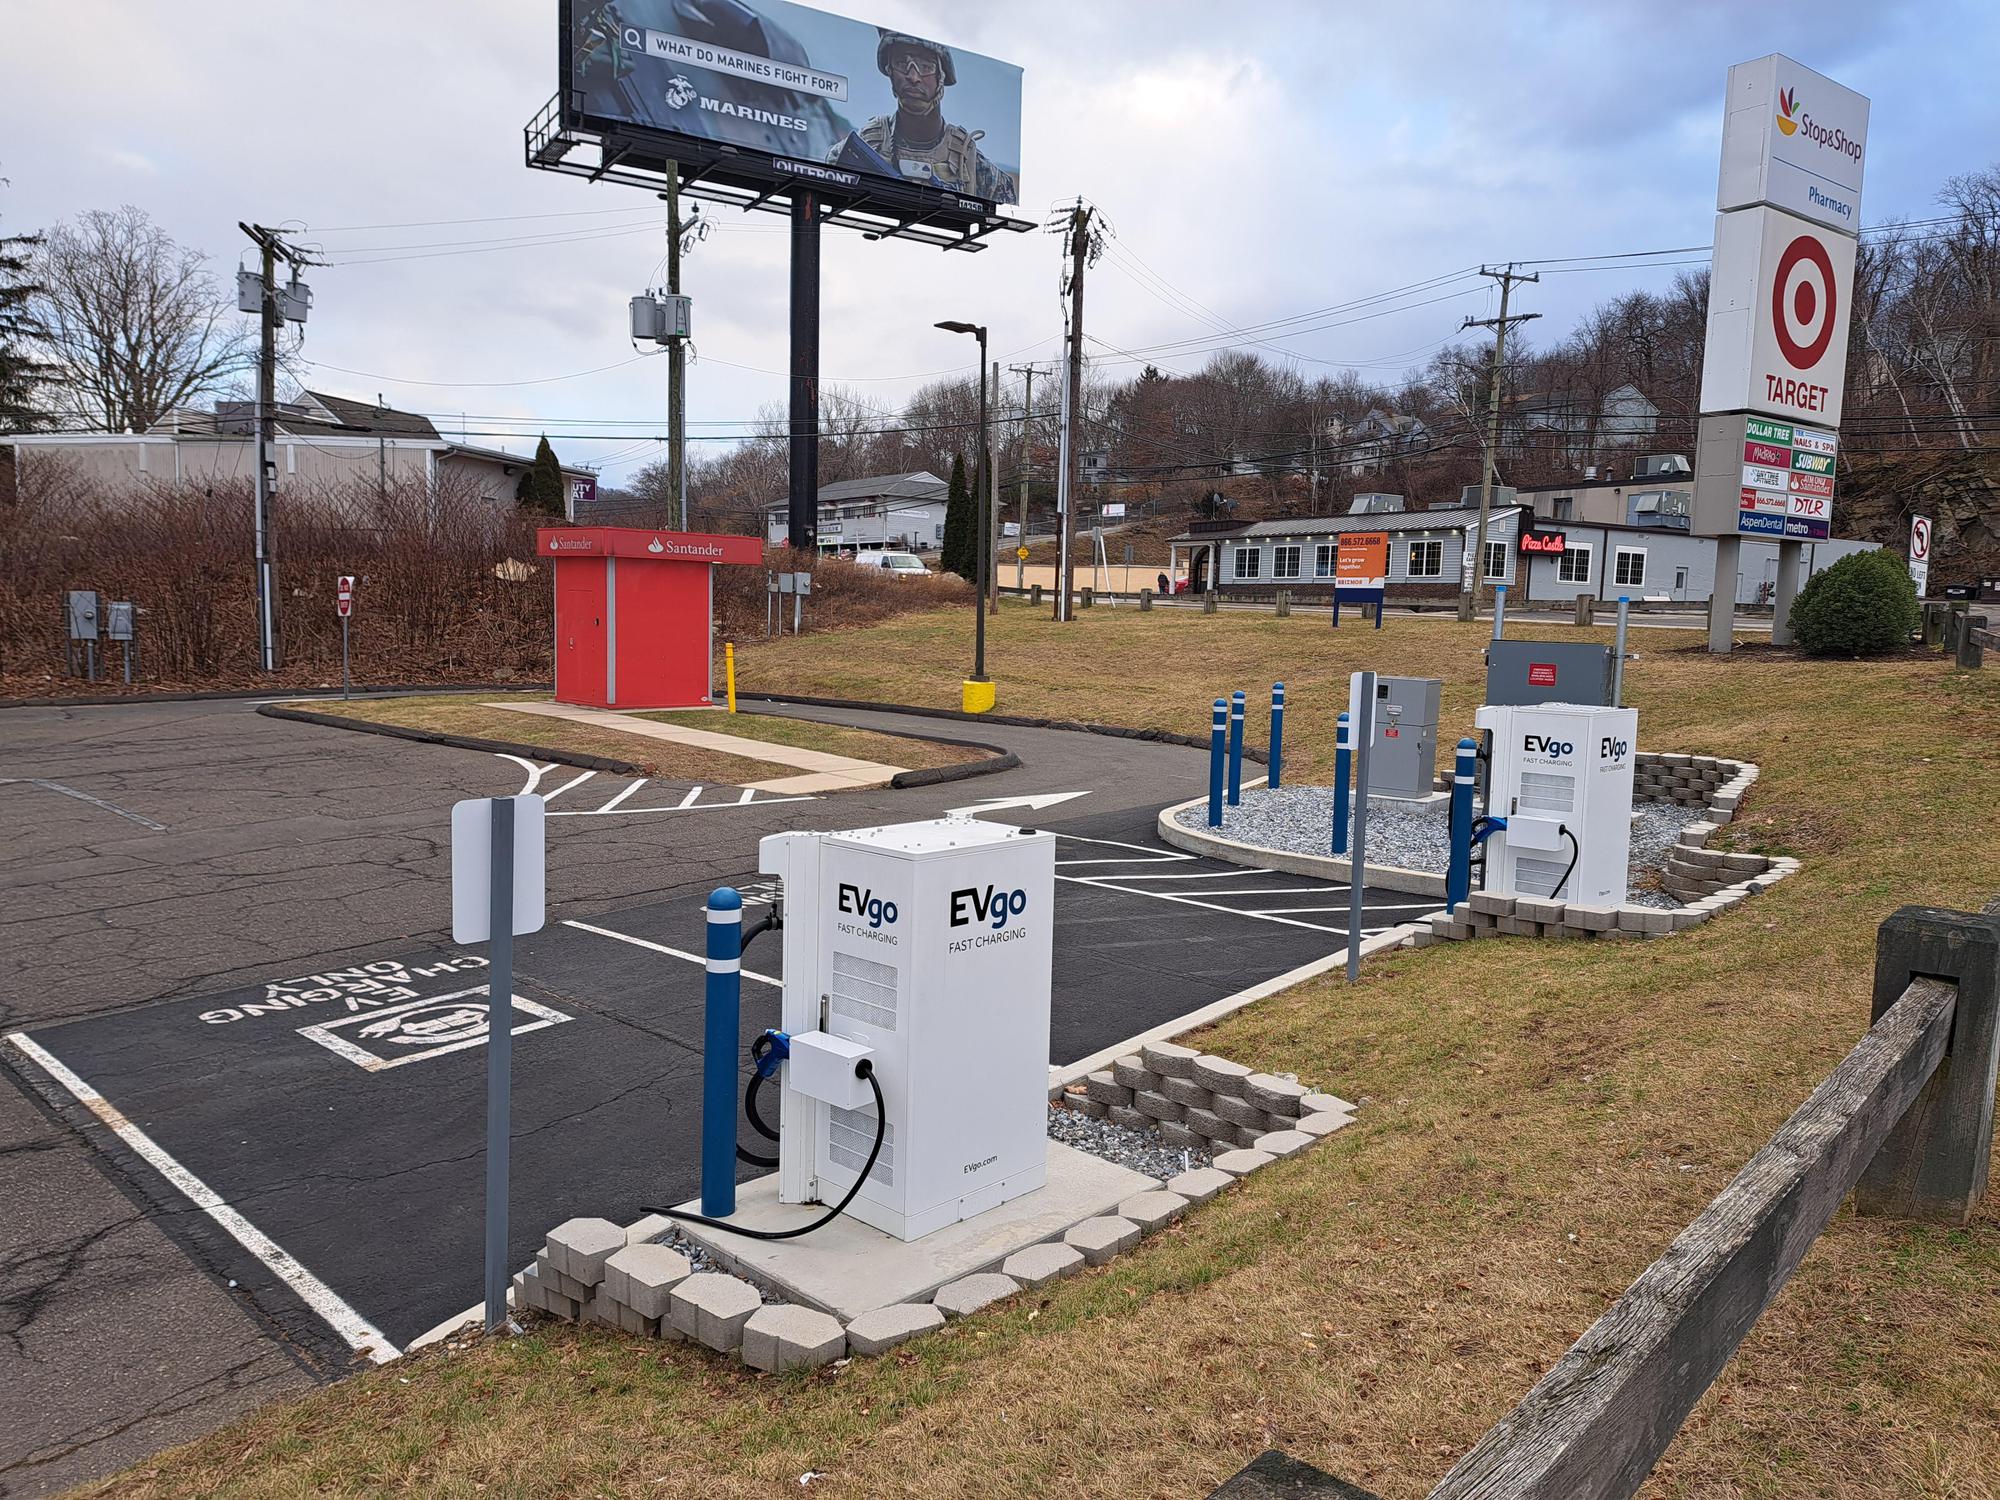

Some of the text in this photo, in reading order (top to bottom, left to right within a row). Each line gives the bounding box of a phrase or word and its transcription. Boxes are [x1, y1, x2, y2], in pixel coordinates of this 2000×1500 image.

[655, 38, 839, 93] WHAT DO MARINES FIGHT FOR?
[700, 96, 808, 132] MARINES
[1801, 113, 1862, 164] Stop&Shop
[776, 160, 856, 184] OUTFRONT
[1808, 186, 1853, 220] Pharmacy
[1766, 374, 1829, 412] TARGET
[1746, 422, 1790, 441] DOLLAR TREE
[1794, 437, 1834, 452] NAILS & SPA
[1795, 453, 1831, 472] SUBWAY
[1800, 478, 1831, 494] Santander
[1794, 497, 1824, 516] DTLR
[1786, 521, 1809, 535] metro
[559, 536, 593, 551] Santander
[666, 540, 724, 557] Santander
[1521, 534, 1564, 551] Pizza Castle
[1524, 734, 1574, 758] EVgo
[1600, 736, 1627, 762] EVgo
[1539, 758, 1573, 767] CHARGING
[839, 882, 898, 929] EVgo
[950, 884, 1027, 929] EVgo
[837, 922, 898, 946] FAST CHARGING
[949, 927, 1026, 954] FAST CHARGING
[199, 956, 490, 1024] CHARGING
[264, 961, 405, 998] ONLY
[344, 986, 421, 1012] EV
[963, 1155, 998, 1174] EVgo.com
